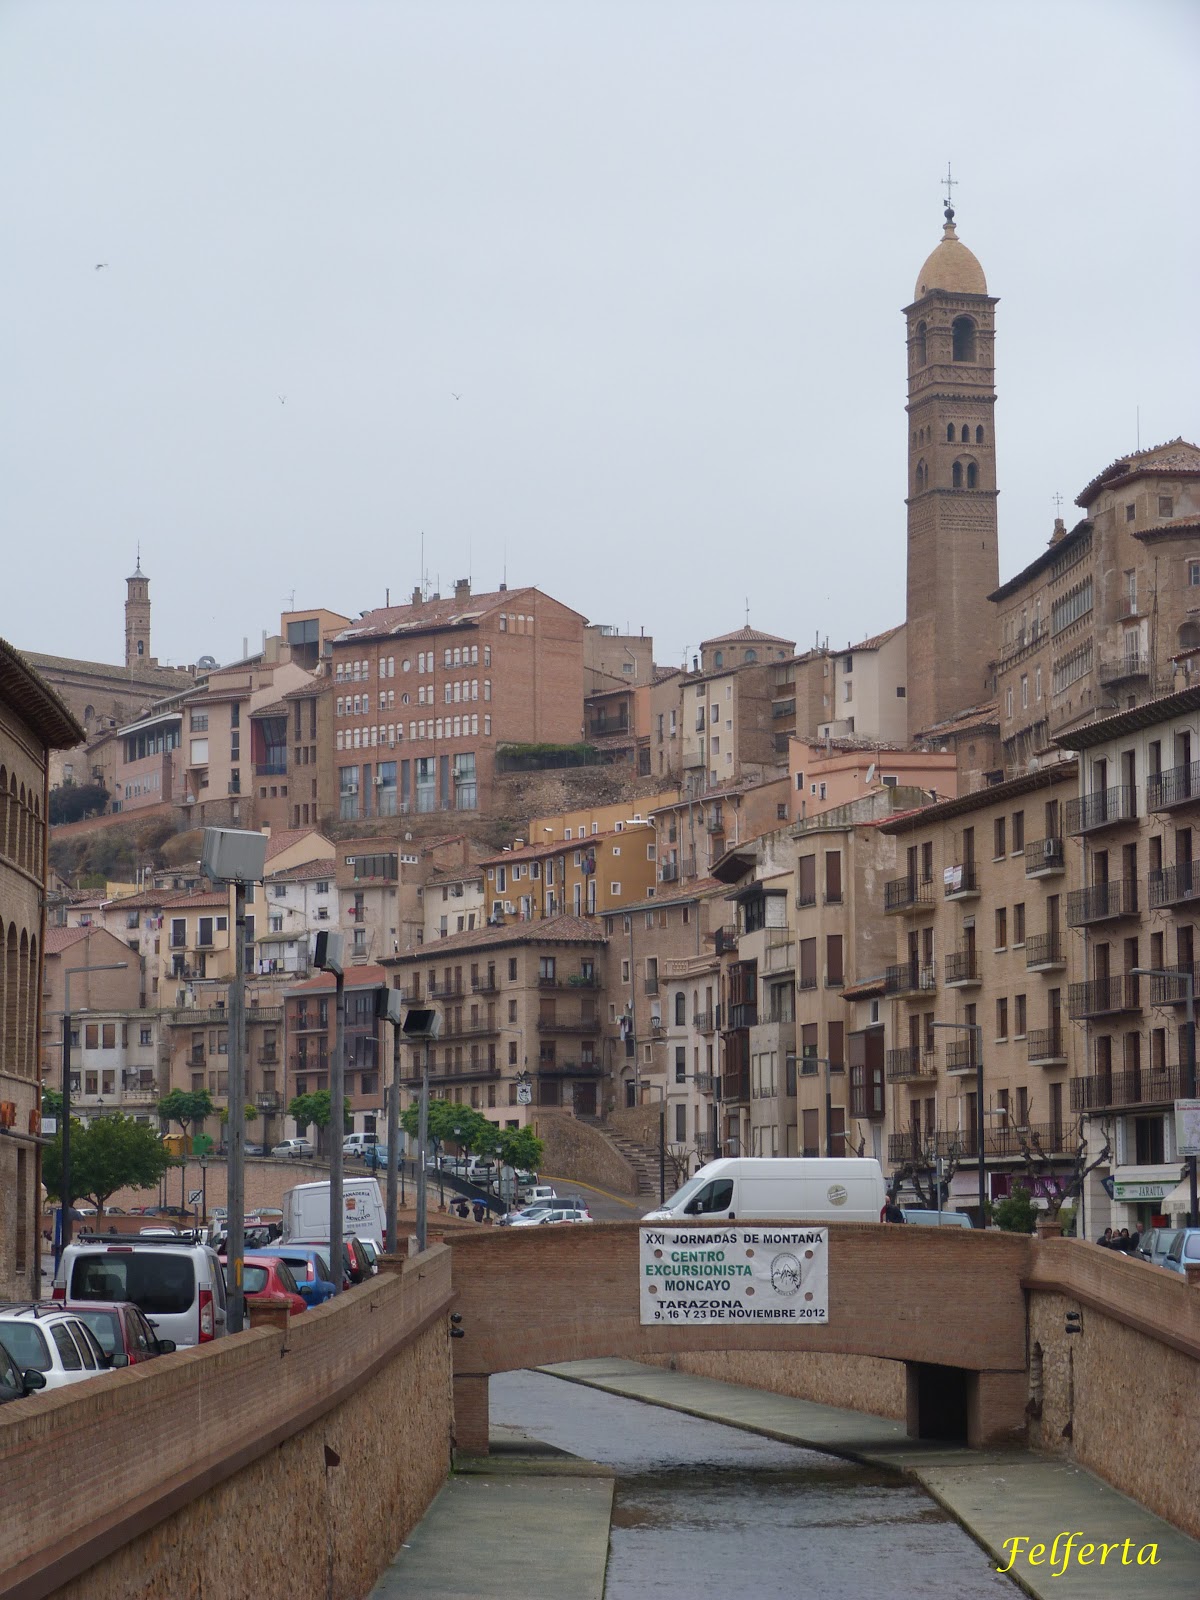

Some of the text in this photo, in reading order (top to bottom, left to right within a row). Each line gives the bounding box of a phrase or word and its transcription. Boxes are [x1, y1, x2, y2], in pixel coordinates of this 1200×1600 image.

[646, 1231, 823, 1244] XXI JORNADAS DE MONTAÑA
[671, 1251, 725, 1262] CENTRO
[645, 1264, 752, 1276] EXCURSIONISTA
[664, 1280, 731, 1291] MONCAYO
[657, 1300, 743, 1309] TARAZONA
[654, 1308, 825, 1320] 9, 16 Y 23 DE NOVIEMBRE 2012
